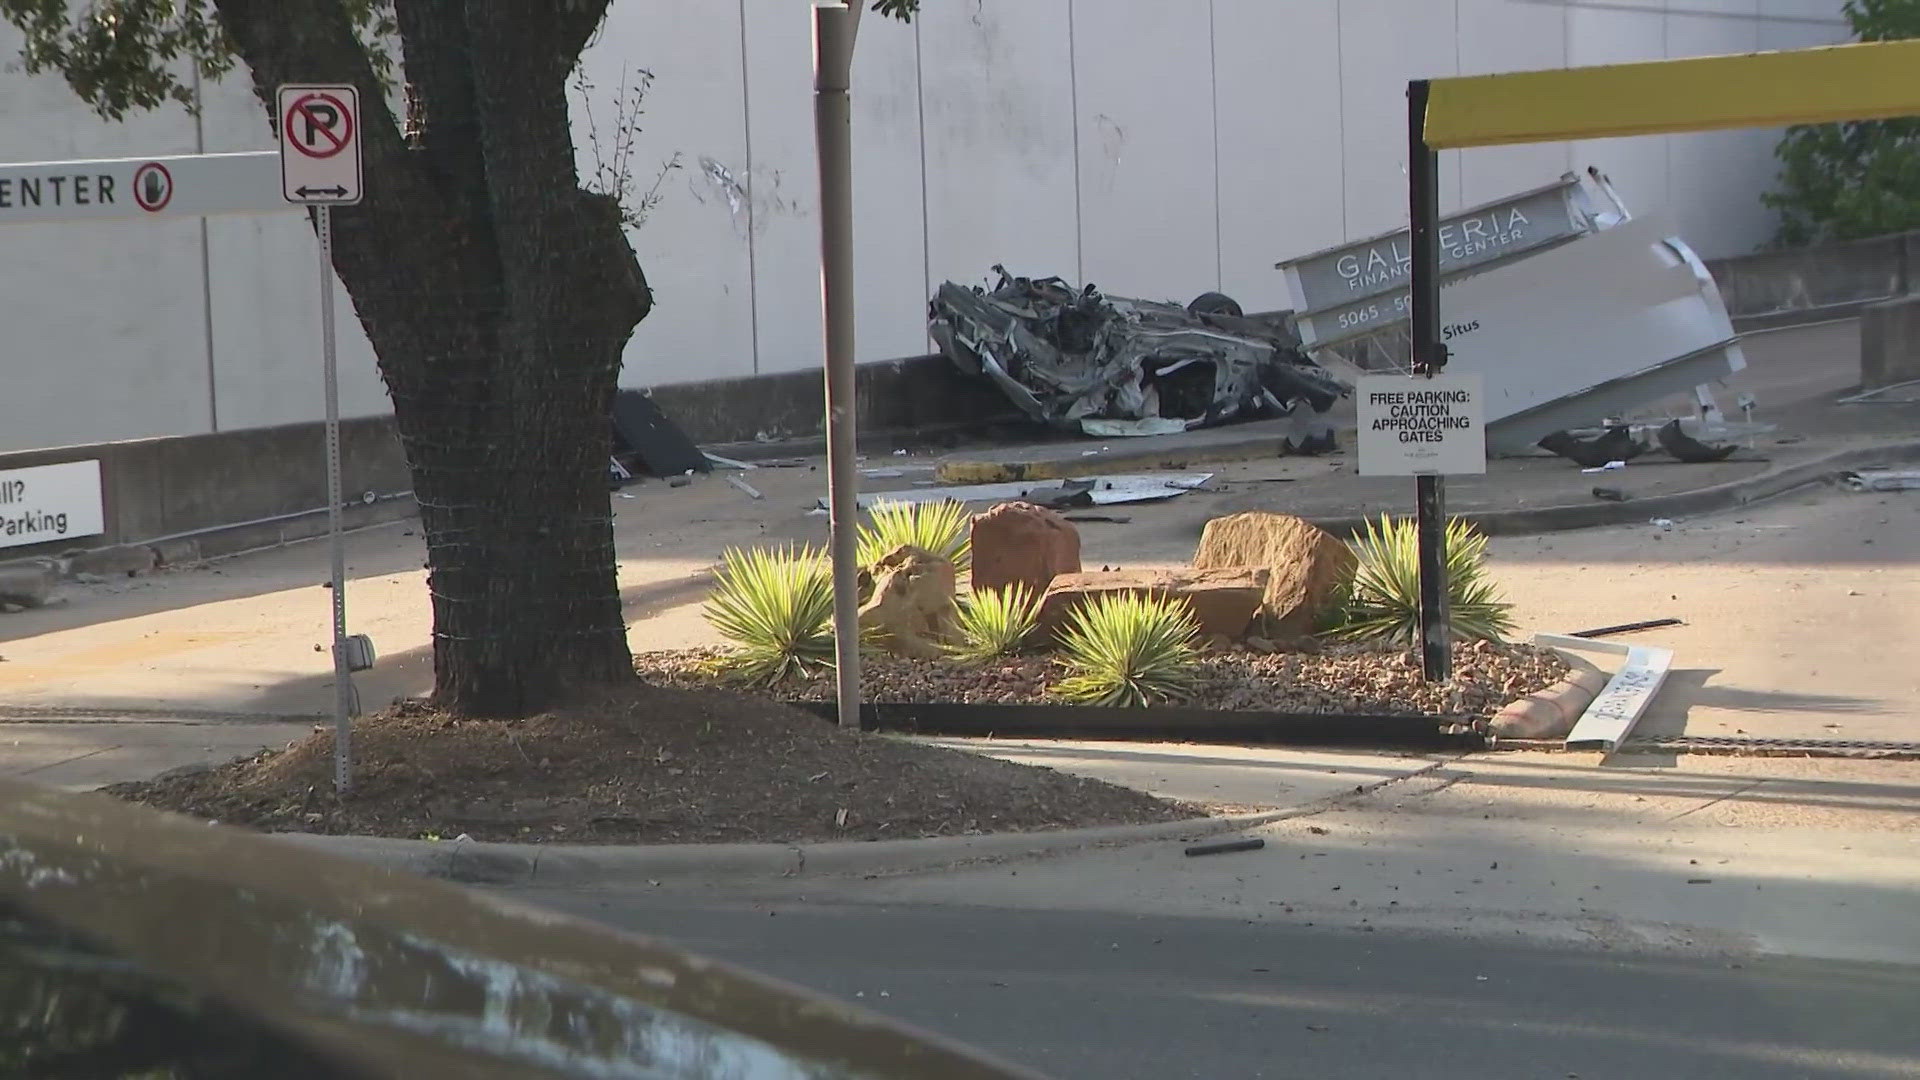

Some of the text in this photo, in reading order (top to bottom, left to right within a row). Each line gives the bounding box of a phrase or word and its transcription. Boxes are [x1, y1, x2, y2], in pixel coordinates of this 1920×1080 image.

[304, 104, 338, 146] P
[0, 173, 116, 208] ENTER
[1337, 207, 1529, 280] GALERIA
[1452, 229, 1523, 259] CENTER
[1338, 304, 1379, 329] 5065
[1442, 319, 1480, 340] Situs
[1370, 390, 1470, 405] FREE PARKING:
[1390, 404, 1449, 418] CAUTION
[1372, 416, 1470, 431] APPROACHING
[1398, 431, 1444, 443] GATES
